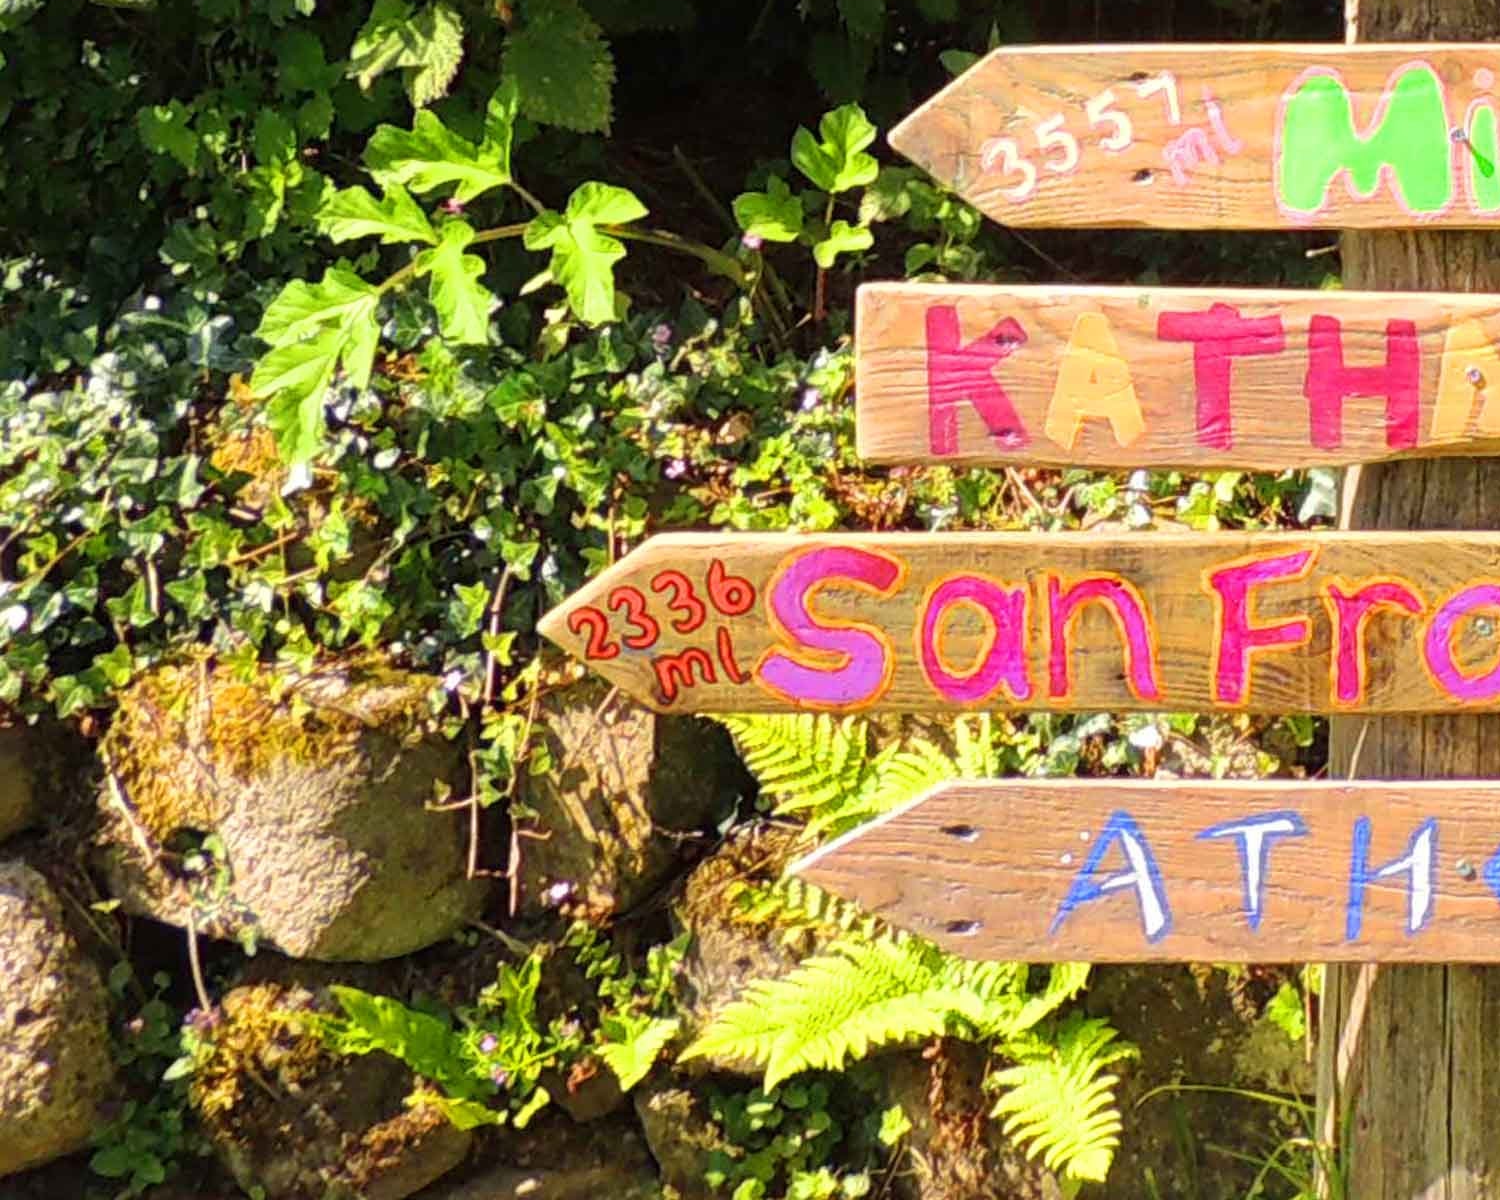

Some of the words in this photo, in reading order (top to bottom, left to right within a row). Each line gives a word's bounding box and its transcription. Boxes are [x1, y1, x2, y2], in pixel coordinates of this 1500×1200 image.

[979, 70, 1182, 200] 3557
[568, 558, 756, 660] 2336
[752, 541, 1162, 712] San
